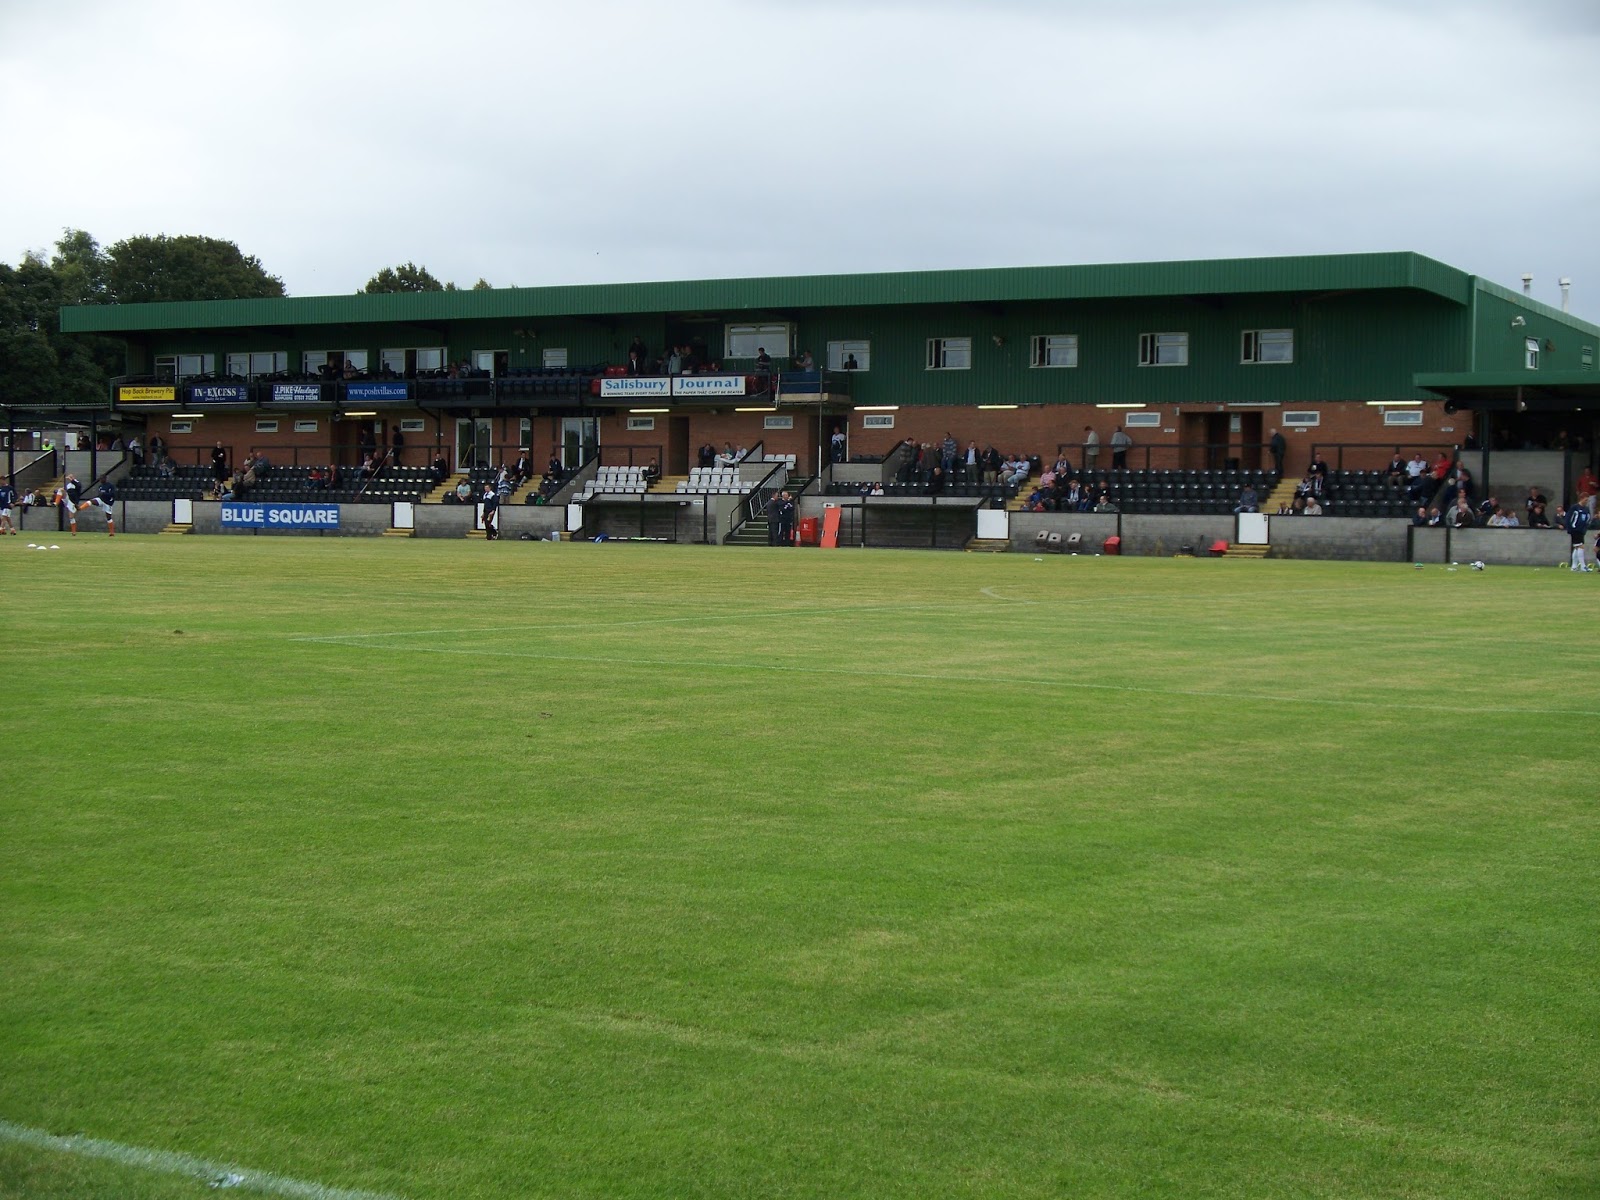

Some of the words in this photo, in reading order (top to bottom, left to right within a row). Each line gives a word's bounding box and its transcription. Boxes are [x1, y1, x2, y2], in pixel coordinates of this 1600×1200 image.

[605, 379, 667, 391] Salisbury
[679, 377, 739, 390] Journal
[145, 387, 165, 395] Brewery
[348, 385, 406, 397] www.poshvillas.com
[221, 508, 264, 522] BLUE
[268, 509, 338, 524] SQUARE
